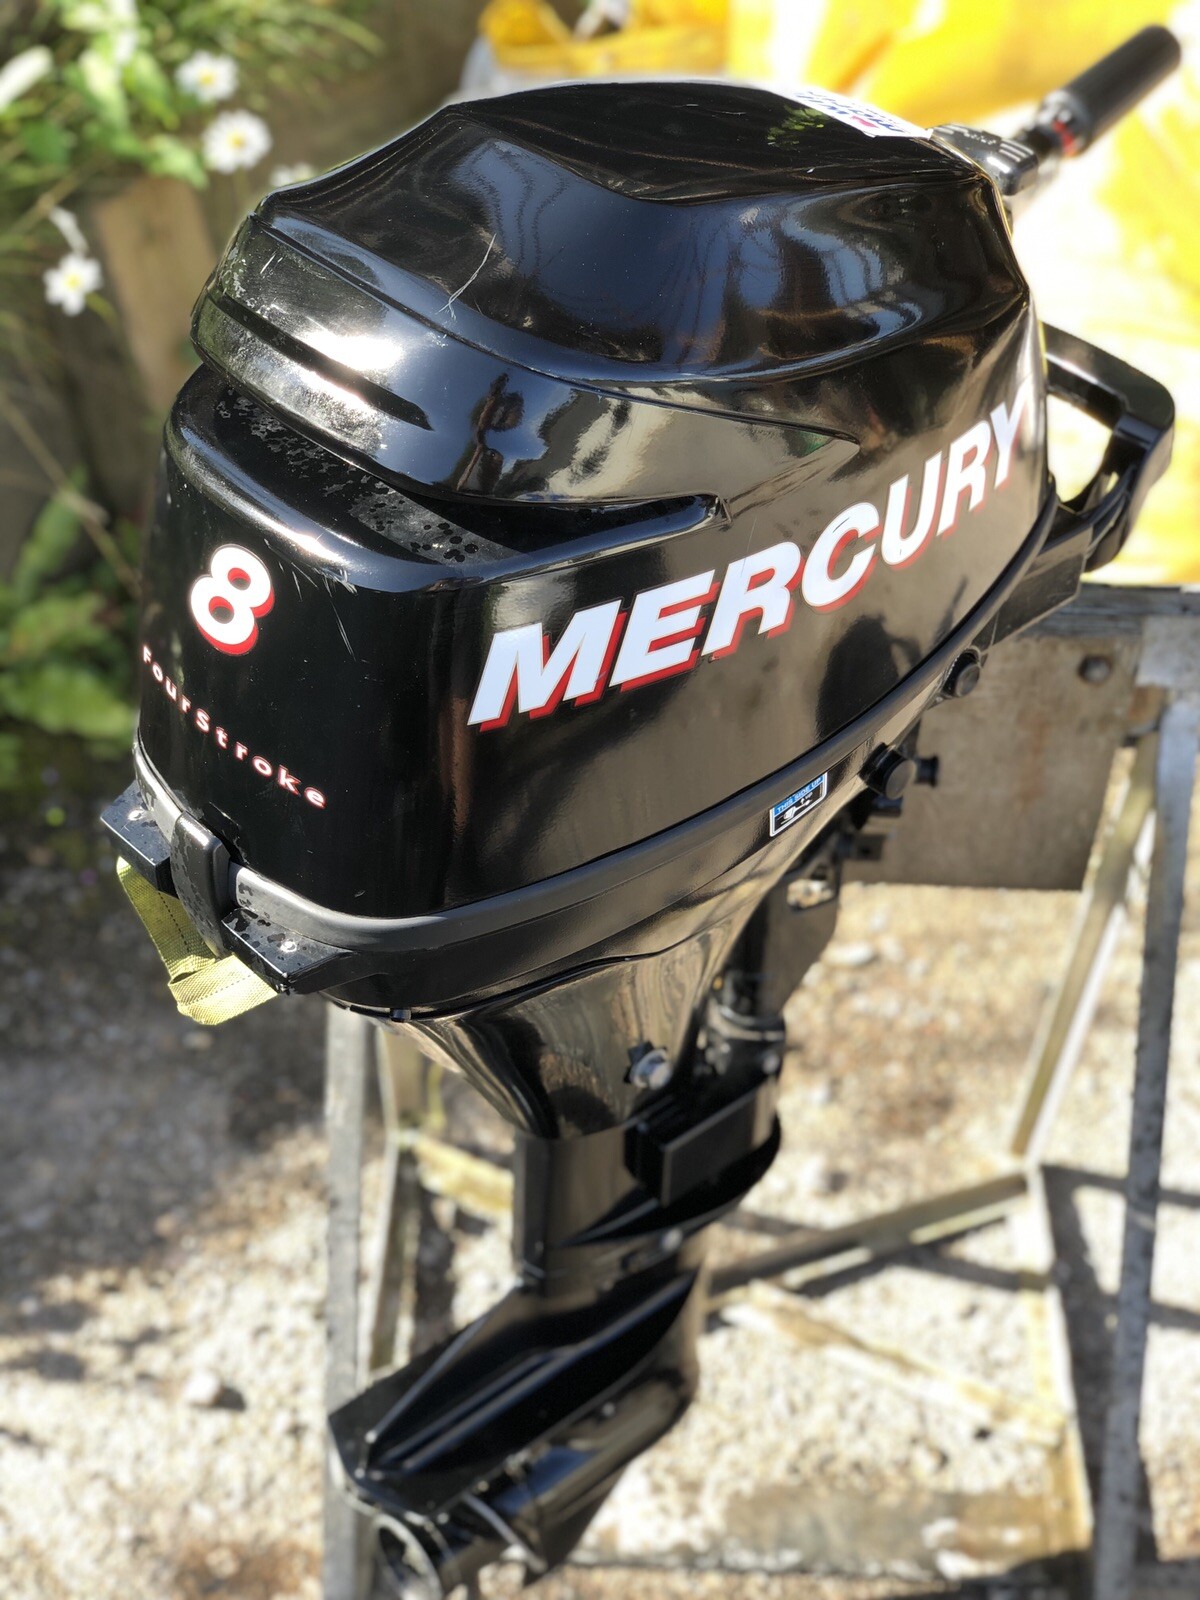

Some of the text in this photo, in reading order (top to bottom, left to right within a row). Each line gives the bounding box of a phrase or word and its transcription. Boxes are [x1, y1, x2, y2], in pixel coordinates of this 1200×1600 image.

[191, 543, 275, 655] 8
[467, 376, 1034, 731] MERCURY
[777, 778, 822, 812] THIS SIDE UP
